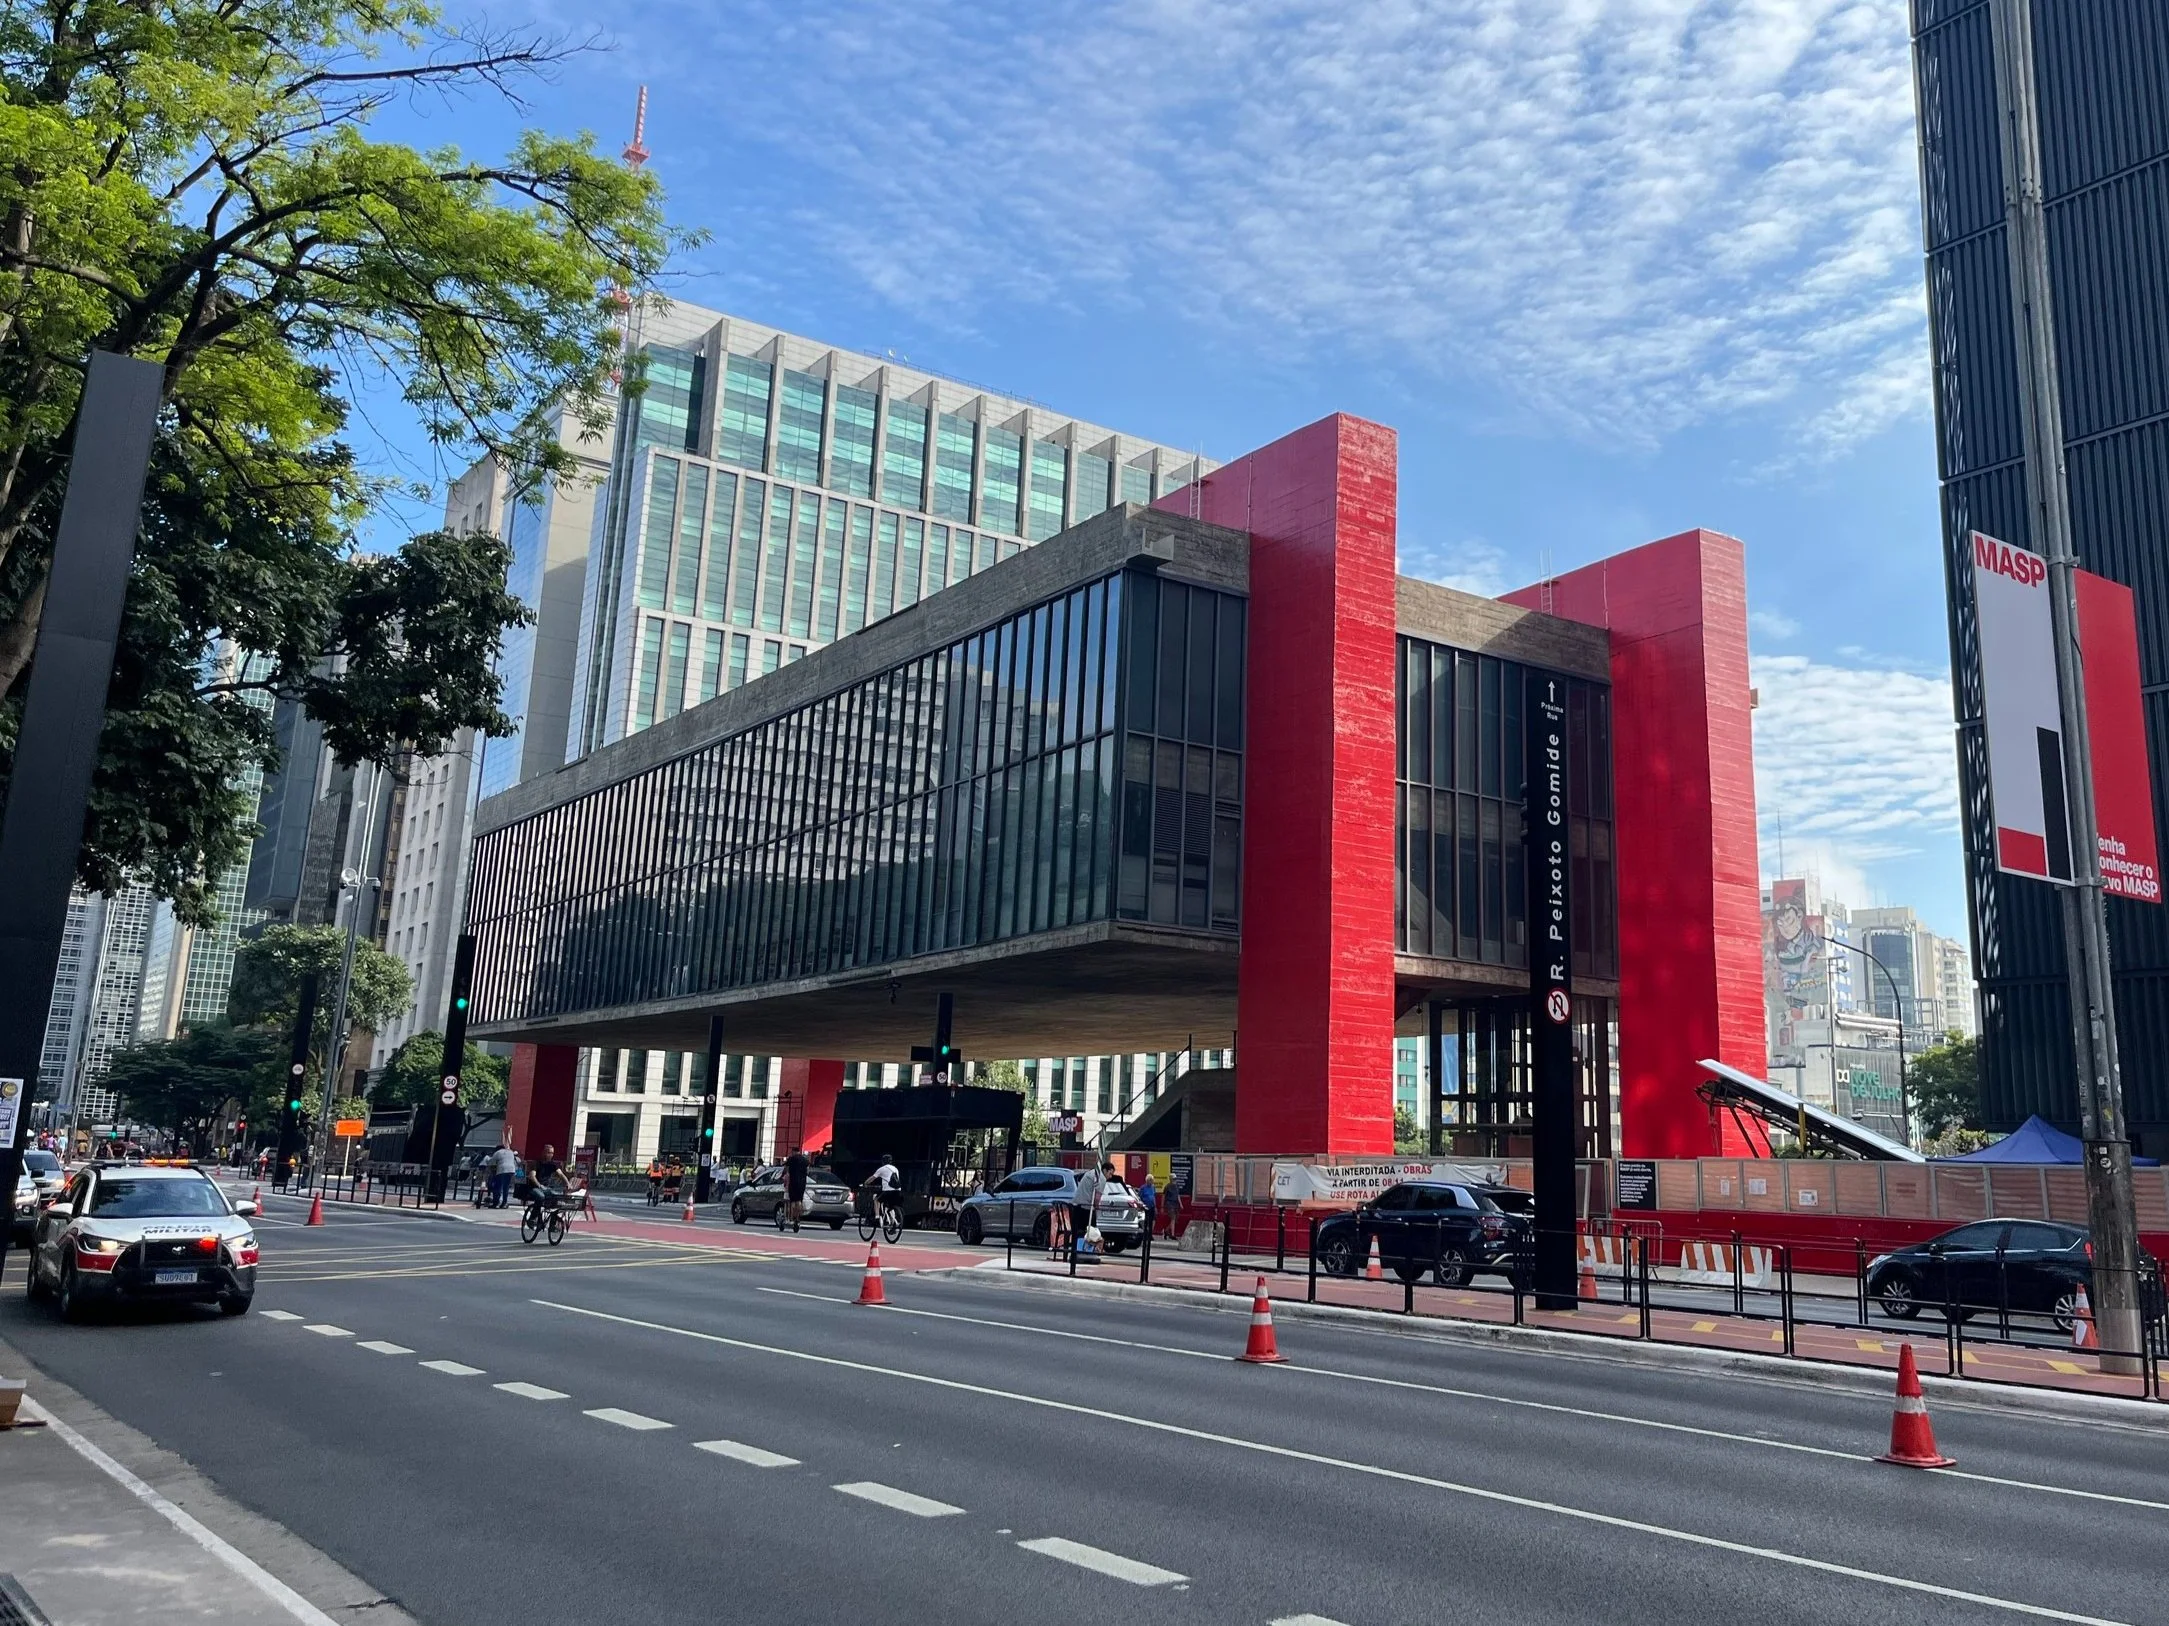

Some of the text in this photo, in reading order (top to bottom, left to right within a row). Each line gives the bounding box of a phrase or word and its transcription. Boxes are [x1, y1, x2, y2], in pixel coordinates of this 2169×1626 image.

[1974, 535, 2045, 588] MASP
[2096, 833, 2126, 856] enha
[1547, 733, 1564, 981] R. Peixoto Gomide
[2099, 855, 2153, 879] onhecer o
[2122, 875, 2158, 898] MASP
[446, 1078, 457, 1086] 50
[1049, 1117, 1078, 1132] MASP
[1327, 1168, 1340, 1177] VIA
[1341, 1165, 1396, 1177] INTERDITADA
[1403, 1165, 1433, 1175] OBRAS
[1332, 1179, 1338, 1187] A
[1339, 1179, 1367, 1188] PARTIR
[1369, 1178, 1380, 1187] DE
[1330, 1190, 1345, 1199] USE
[1347, 1190, 1369, 1199] ROTA
